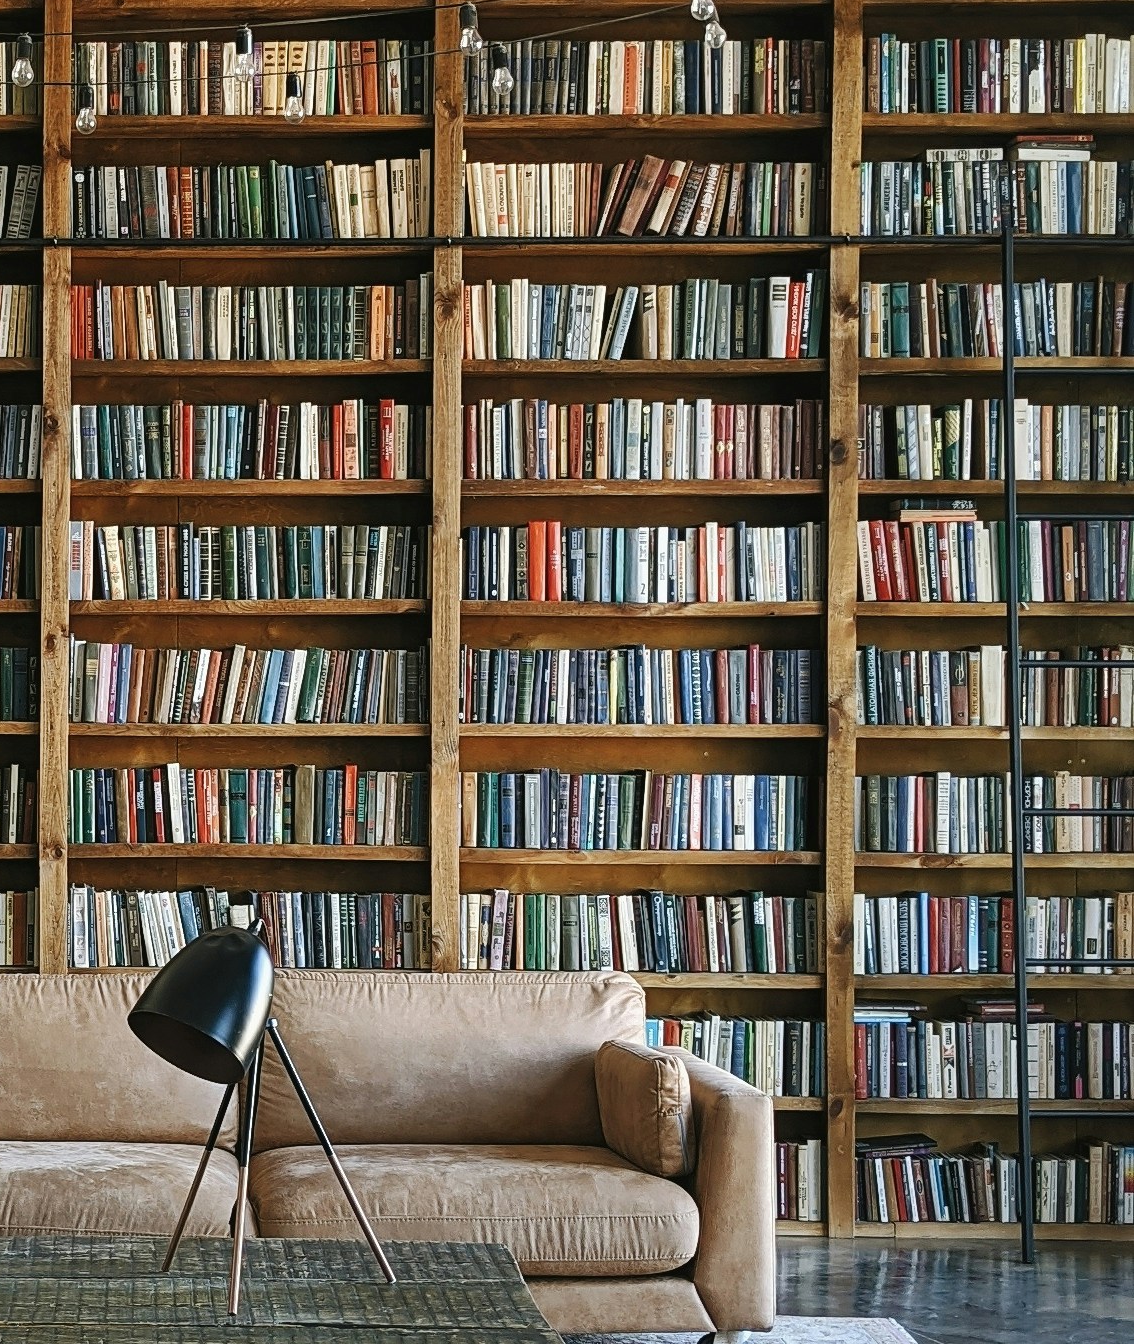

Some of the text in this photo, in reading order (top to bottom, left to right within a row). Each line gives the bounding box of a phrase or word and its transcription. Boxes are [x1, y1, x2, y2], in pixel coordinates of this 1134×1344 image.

[868, 678, 876, 713] АТОМНАЯ
[899, 900, 908, 971] МОСКОВСКИЙ КЛУБ
